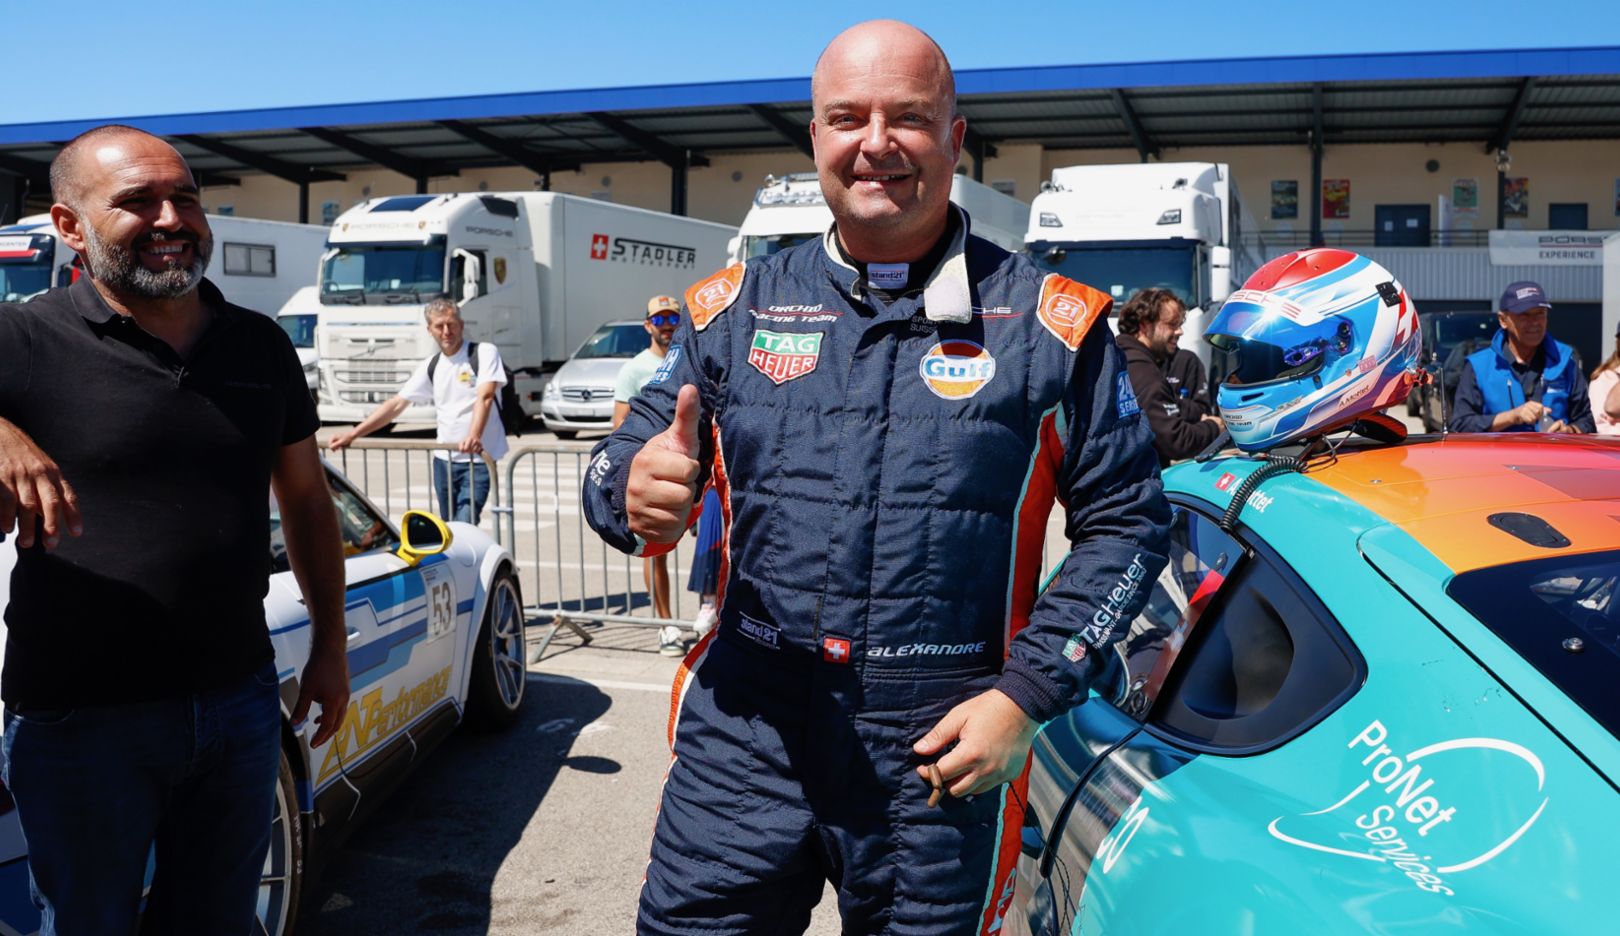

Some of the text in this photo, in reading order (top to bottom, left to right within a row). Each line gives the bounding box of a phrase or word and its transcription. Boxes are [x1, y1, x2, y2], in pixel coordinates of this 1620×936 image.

[1538, 235, 1606, 244] PORS
[611, 238, 696, 264] STADLER
[1538, 250, 1596, 260] EXPERIENCE
[703, 282, 725, 303] 21
[768, 303, 823, 313] ORCHID
[1053, 299, 1080, 319] 21
[760, 333, 815, 353] TAG
[753, 351, 814, 379] HEUER
[924, 357, 992, 377] Gulf
[431, 581, 452, 632] 53
[1347, 719, 1458, 837] ProNet
[1355, 804, 1456, 897] Services
